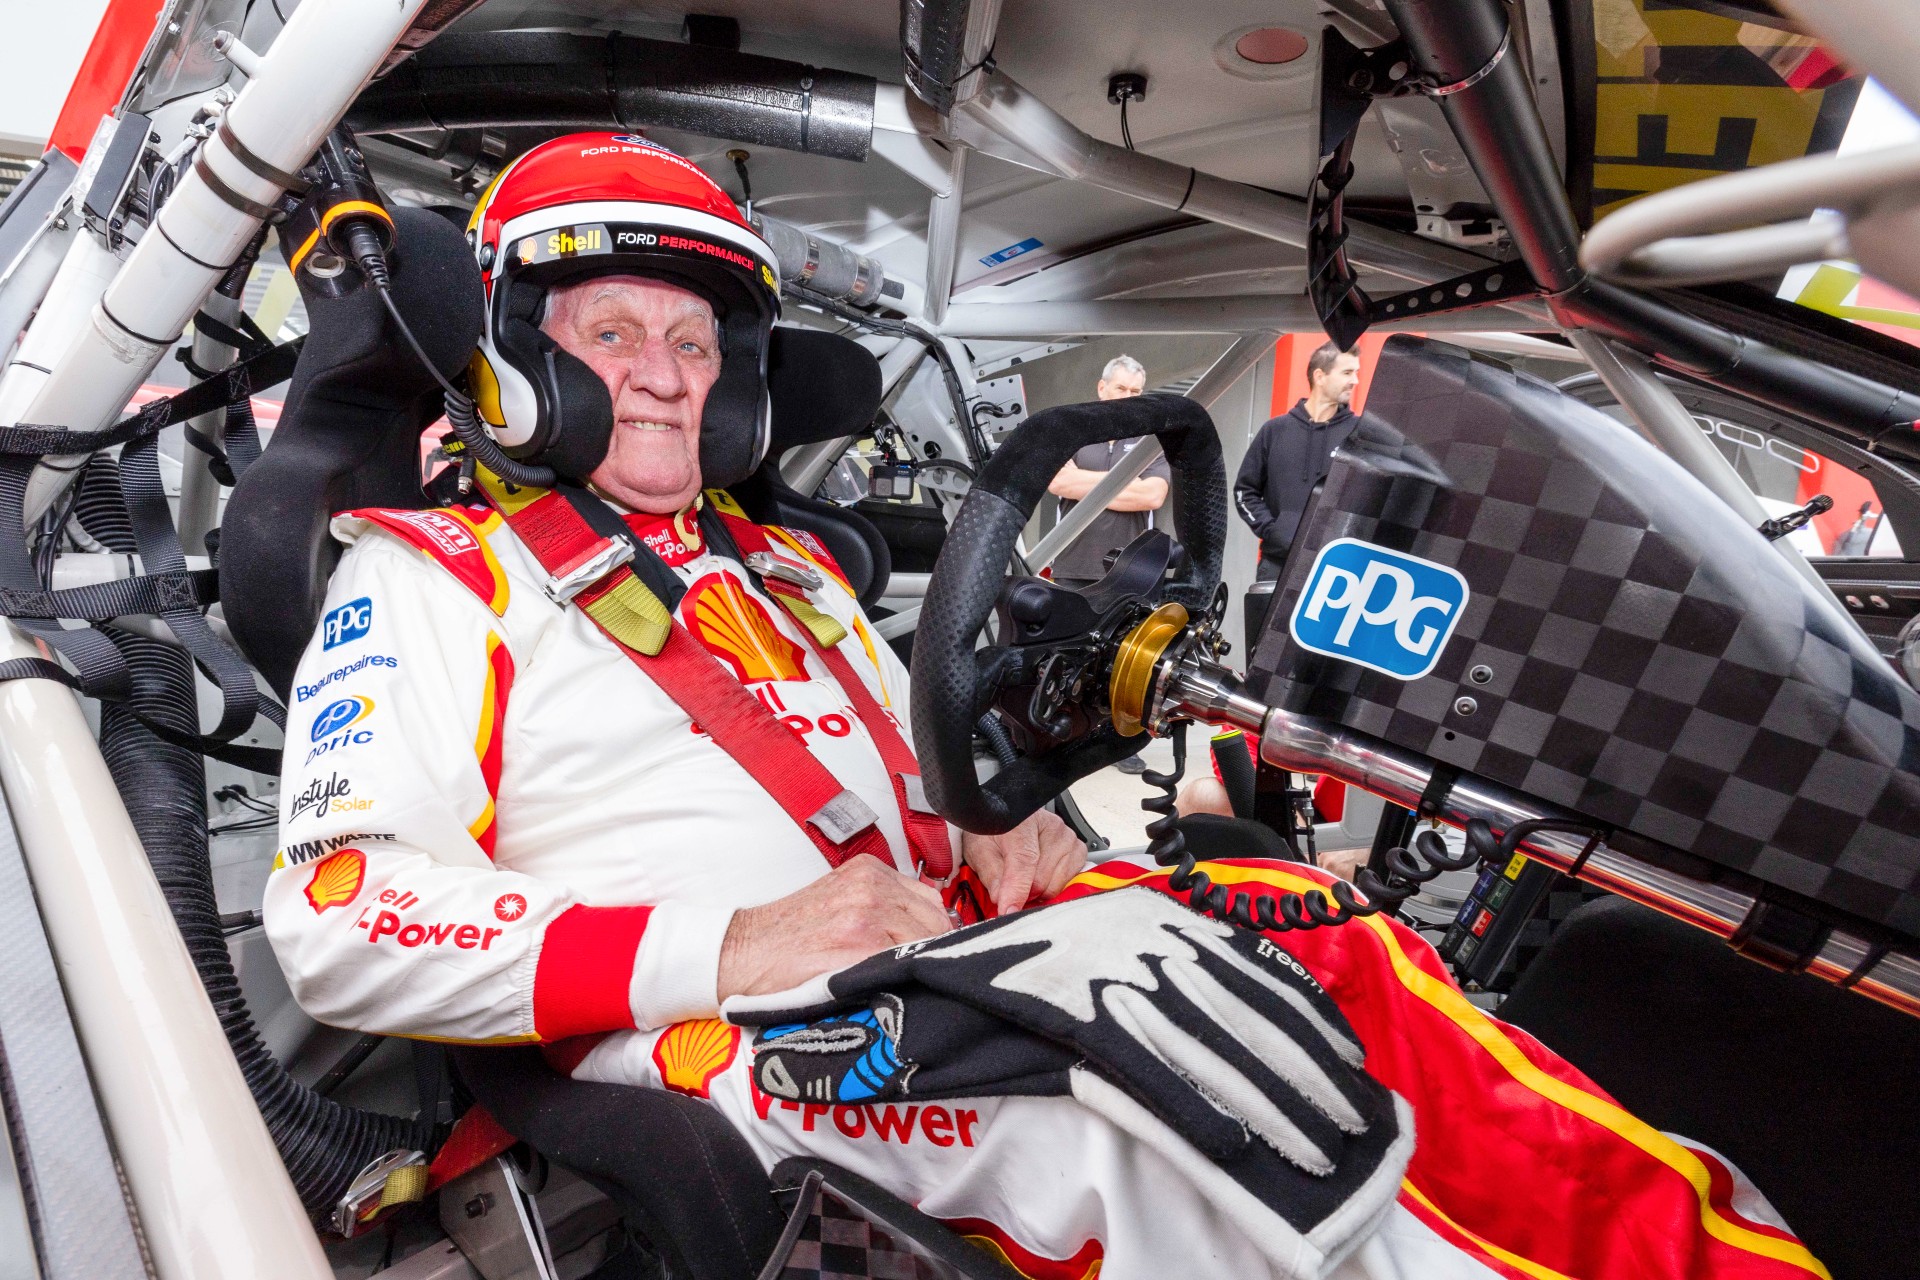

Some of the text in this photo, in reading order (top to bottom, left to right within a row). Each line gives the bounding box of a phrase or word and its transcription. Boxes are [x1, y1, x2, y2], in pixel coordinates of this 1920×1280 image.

[581, 146, 619, 157] FORD
[548, 230, 601, 254] Shell
[617, 232, 754, 271] FORD PERFORMANCE
[643, 529, 671, 546] Shell
[326, 605, 370, 645] PPG
[1304, 559, 1453, 656] PPG
[296, 655, 398, 702] Beaurepaires
[289, 771, 351, 821] Instyle
[331, 797, 374, 812] Solar
[287, 833, 397, 865] WM WASTE
[374, 888, 419, 911] ell
[350, 905, 503, 951] -Power
